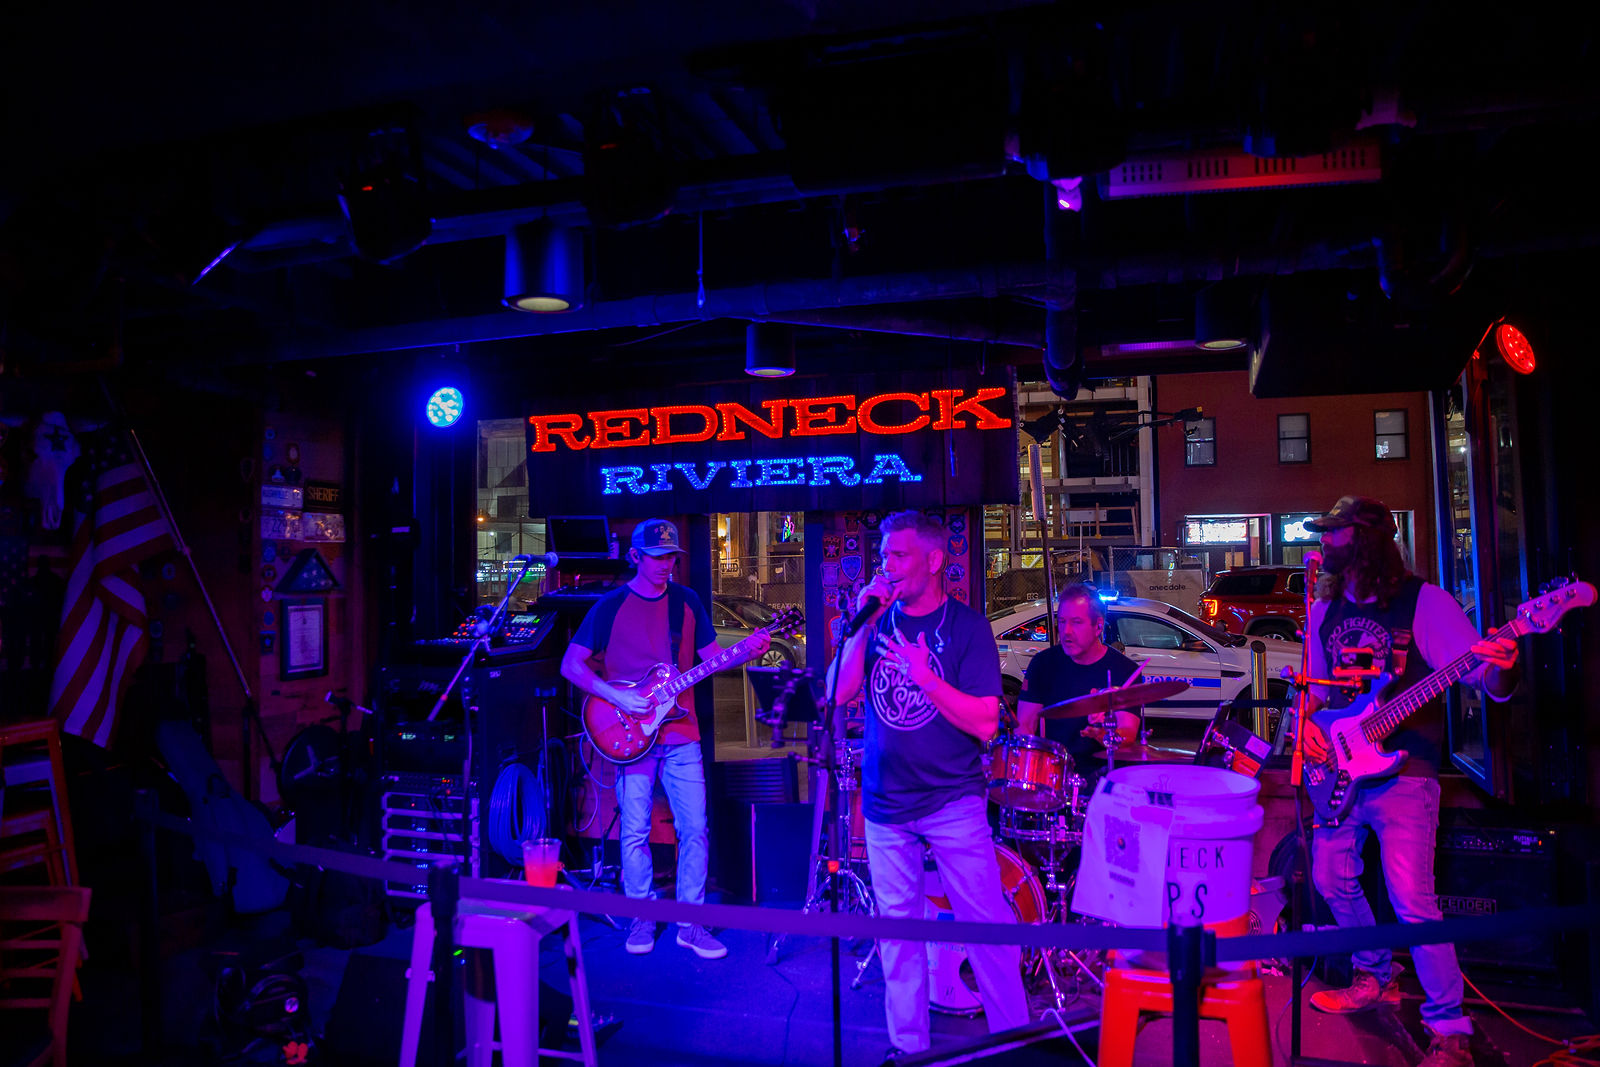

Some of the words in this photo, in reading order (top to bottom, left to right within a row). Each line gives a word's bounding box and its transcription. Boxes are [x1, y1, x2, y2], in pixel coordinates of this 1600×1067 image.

[529, 387, 1012, 452] REDNECK
[308, 486, 339, 502] SHERIFF
[601, 454, 922, 495] RIVIERA
